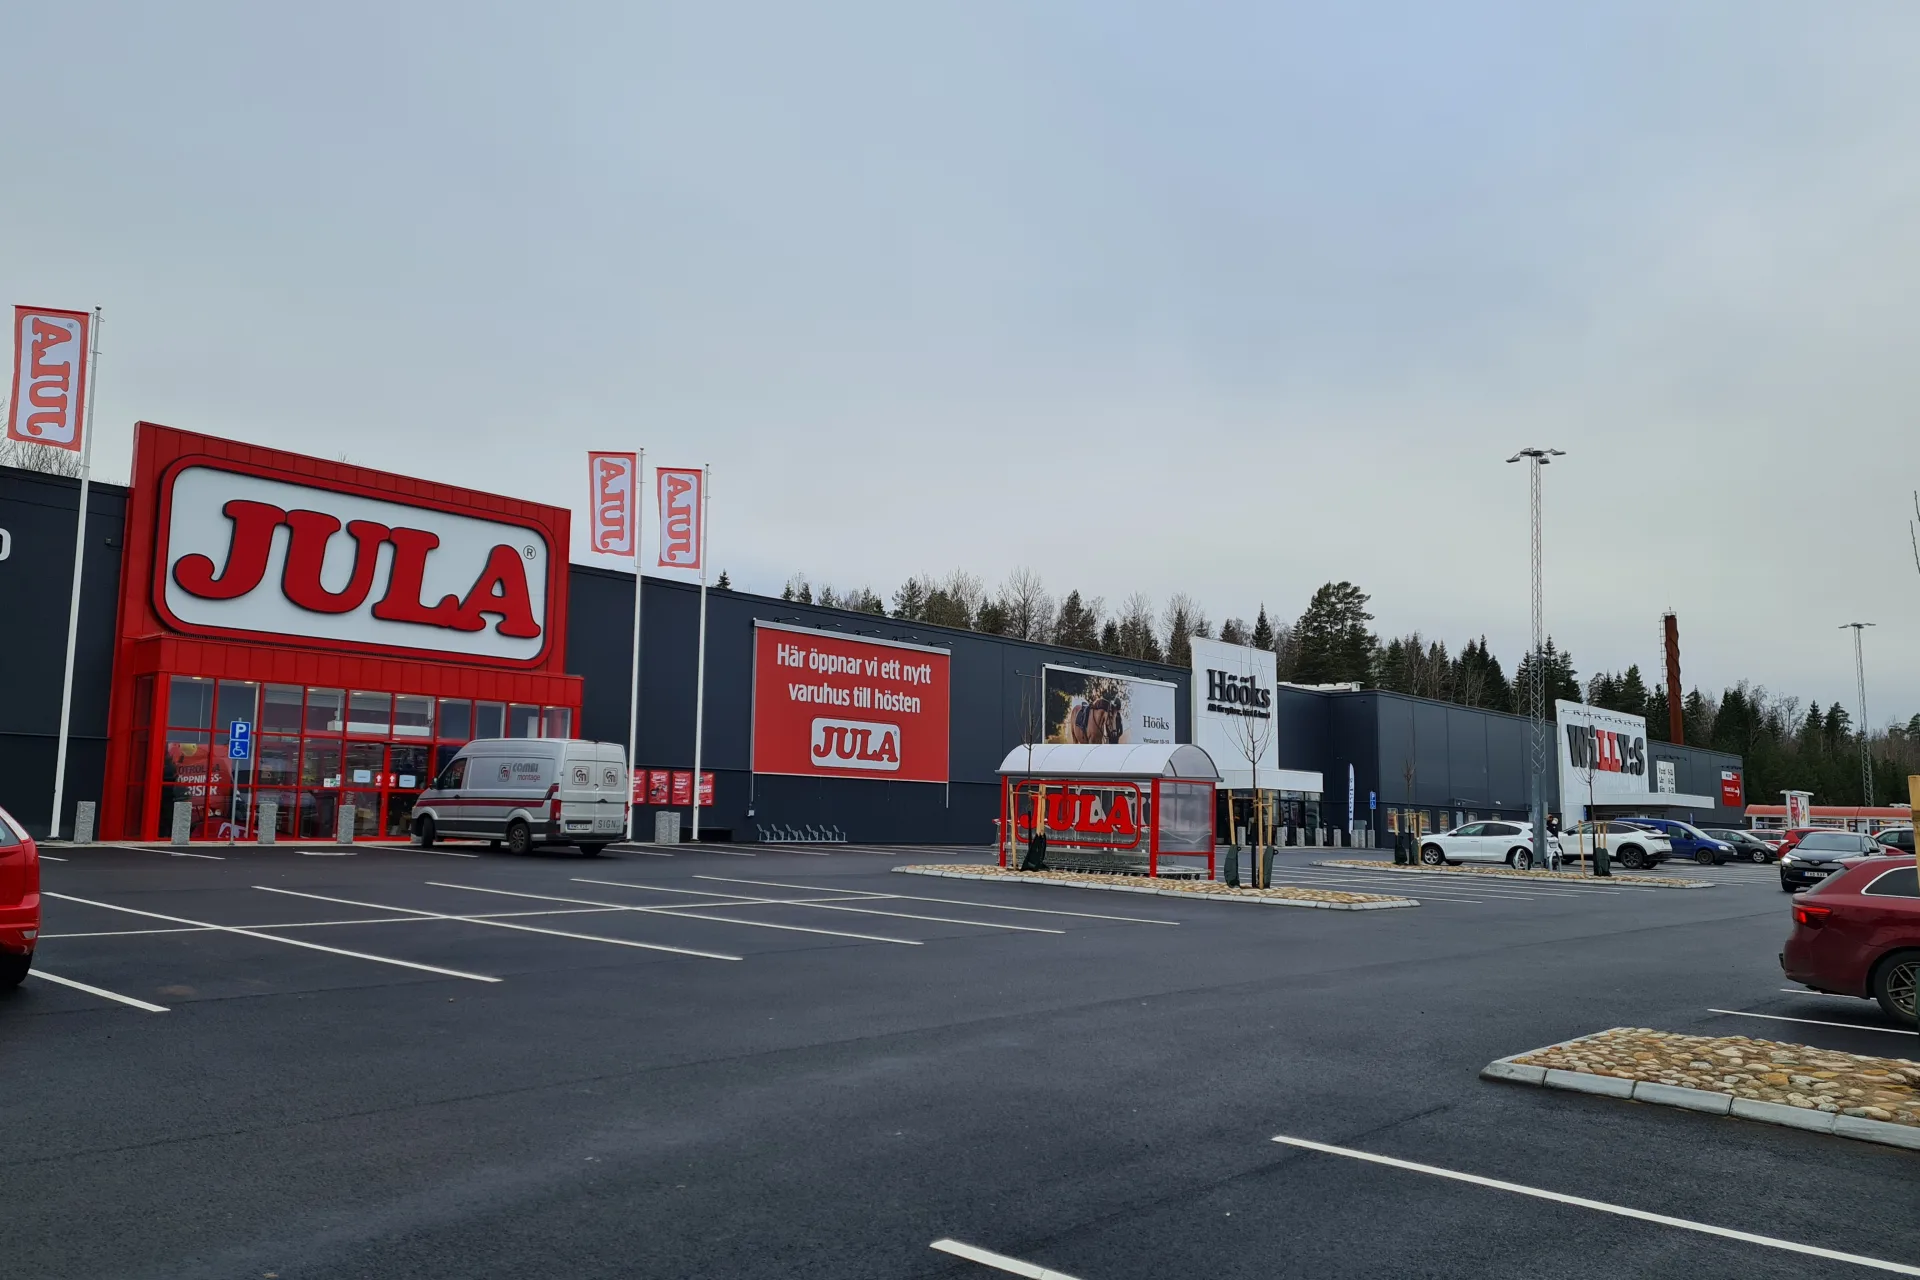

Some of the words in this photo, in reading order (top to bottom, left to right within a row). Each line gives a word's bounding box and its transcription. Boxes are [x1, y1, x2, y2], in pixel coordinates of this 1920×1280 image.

[172, 499, 541, 639] JULA
[777, 643, 806, 668] Här
[809, 648, 862, 675] öppnar
[865, 657, 878, 677] vi
[881, 659, 900, 680] ett
[903, 664, 932, 686] nytt
[788, 683, 850, 706] varuhus
[853, 687, 871, 708] till
[874, 689, 921, 713] hösten
[1207, 669, 1270, 708] Hööks
[235, 723, 247, 738] P
[1143, 715, 1169, 730] Hööks
[813, 726, 898, 763] JULA
[517, 773, 540, 782] montage
